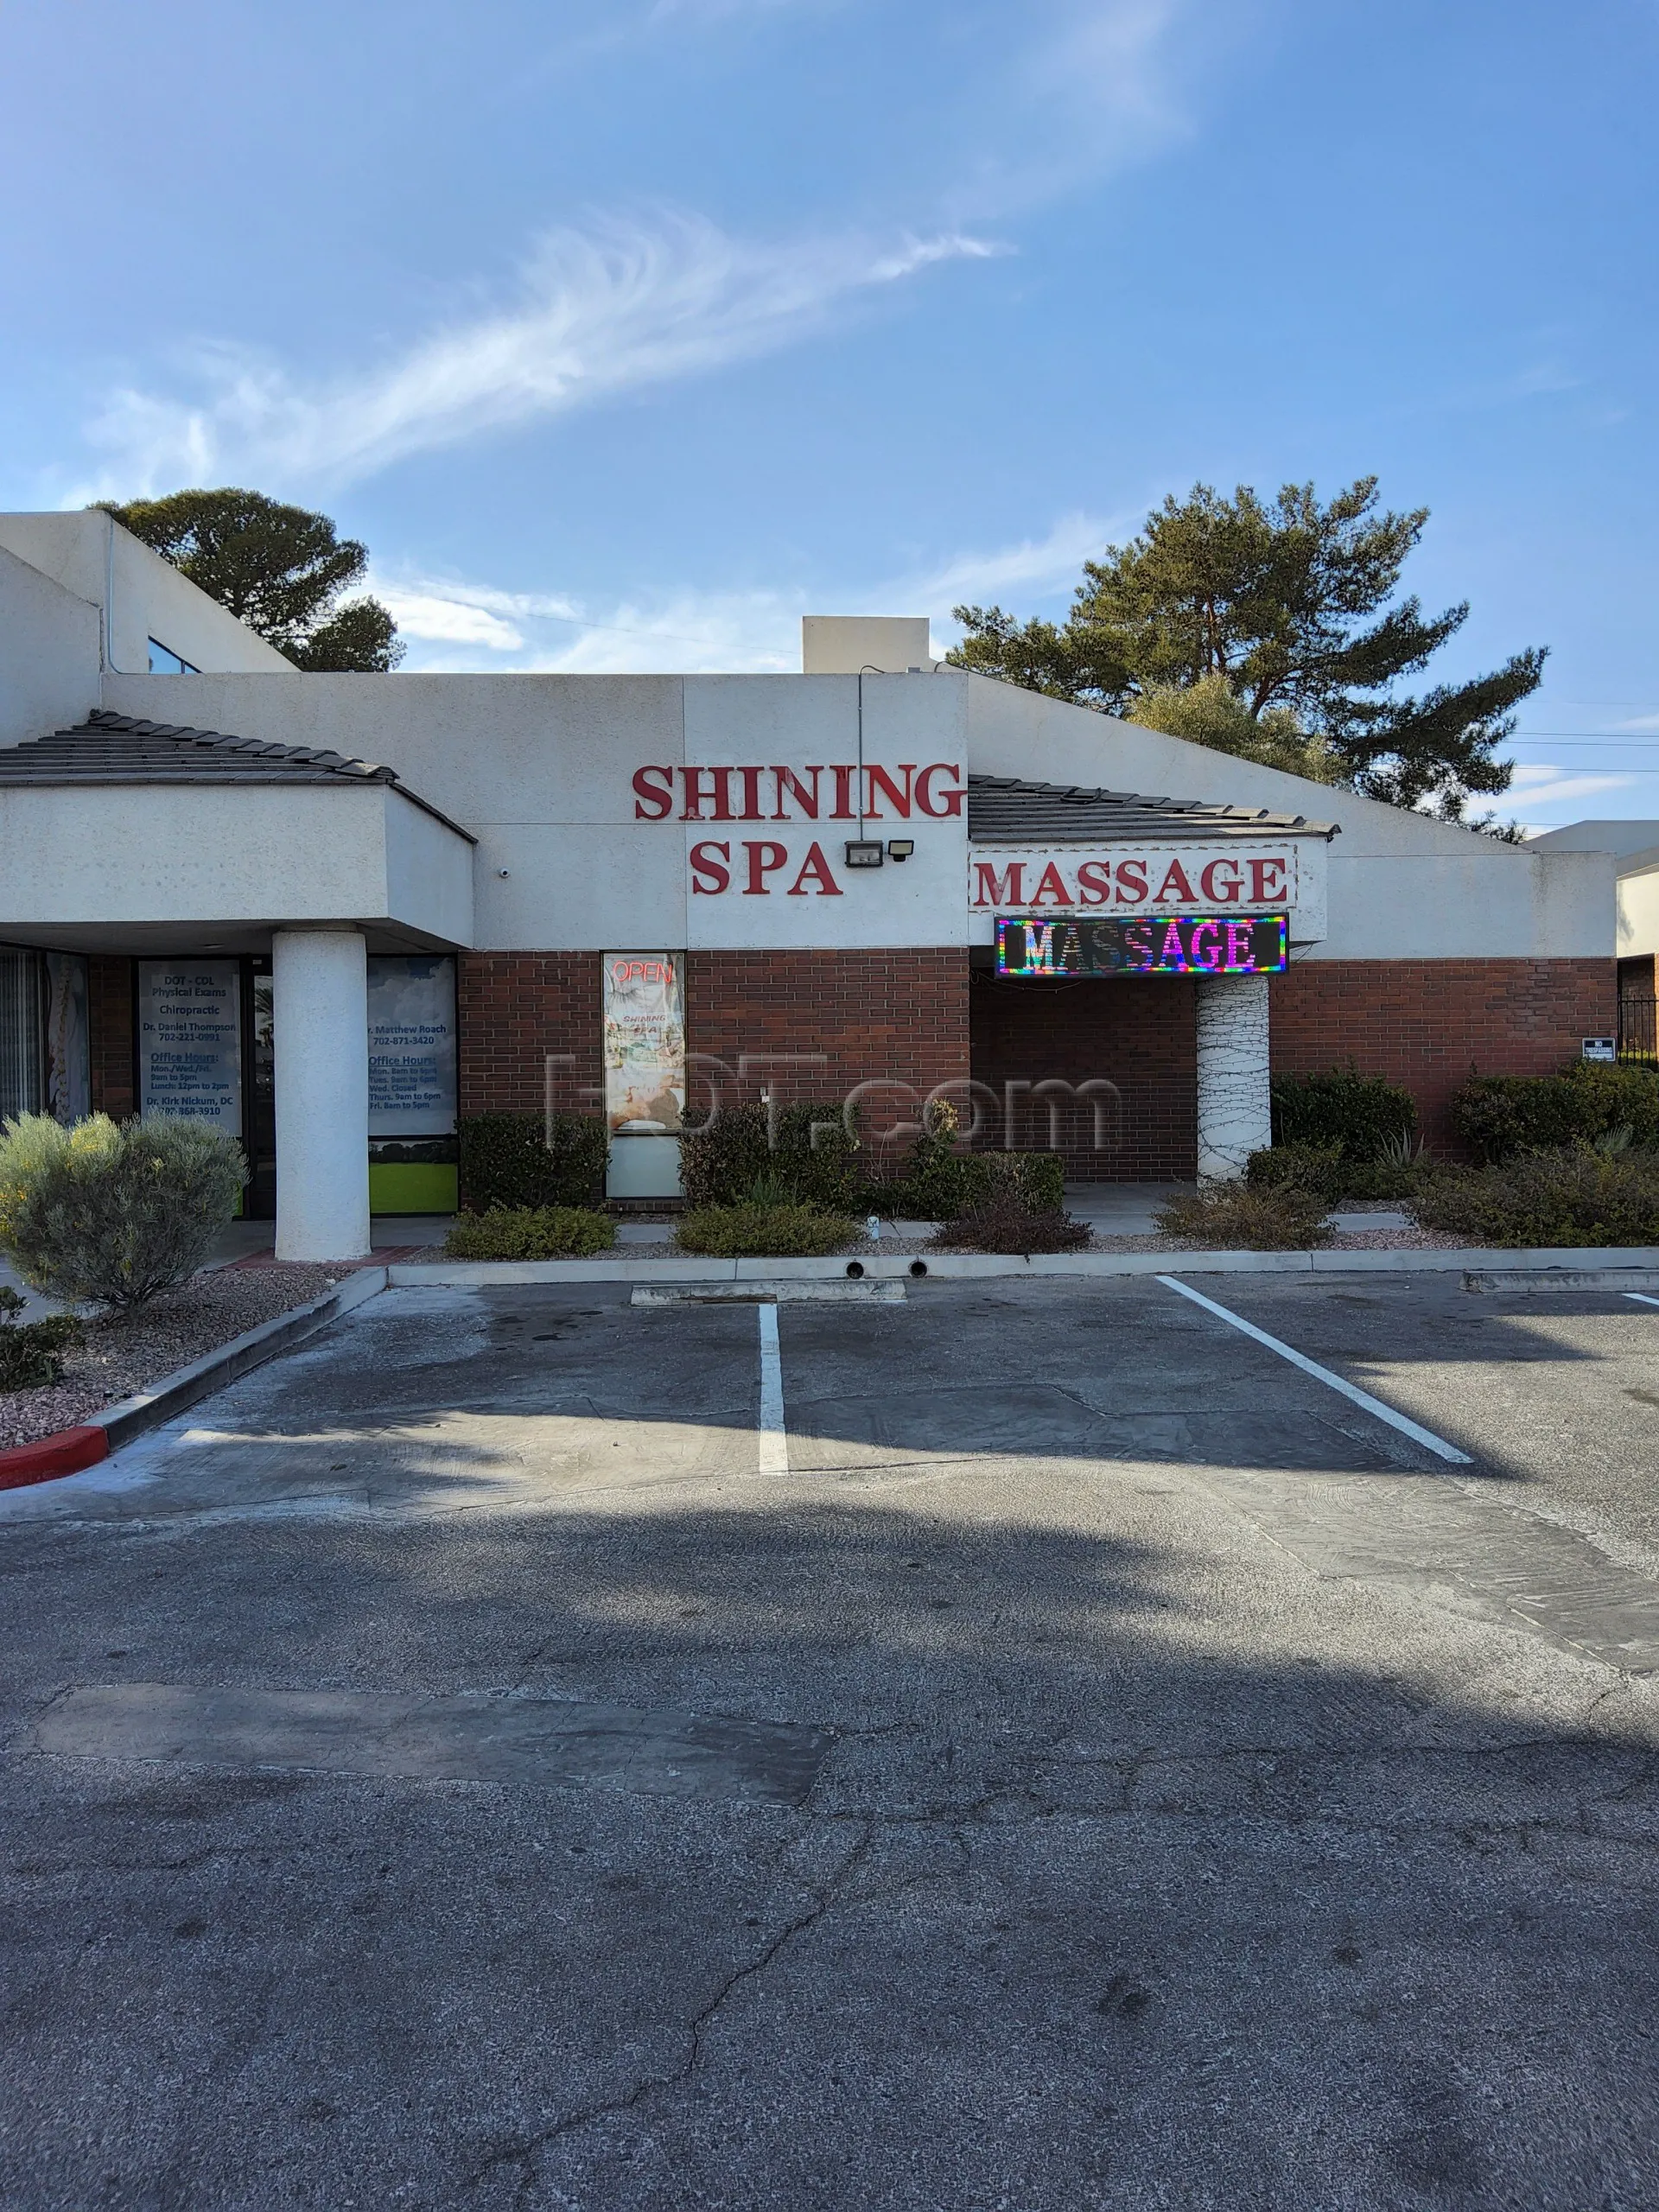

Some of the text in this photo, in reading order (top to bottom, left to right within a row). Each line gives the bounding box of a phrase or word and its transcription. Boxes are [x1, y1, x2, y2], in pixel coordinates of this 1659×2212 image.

[632, 763, 968, 820] SHINING
[690, 841, 843, 895] SPA
[973, 858, 1287, 906] MASSAGE
[1022, 923, 1255, 970] MASSAGE
[613, 961, 673, 983] OPEN
[164, 976, 186, 985] DOT
[195, 976, 214, 985] CDL
[152, 988, 226, 998] Physical Exams
[160, 1005, 219, 1016] Chiropractic
[188, 1023, 236, 1033] Thompson
[419, 1025, 446, 1033] Roach
[150, 1052, 219, 1063] Office Hours:
[368, 1056, 435, 1066] Office Hours:
[181, 1096, 218, 1106] Nickum,
